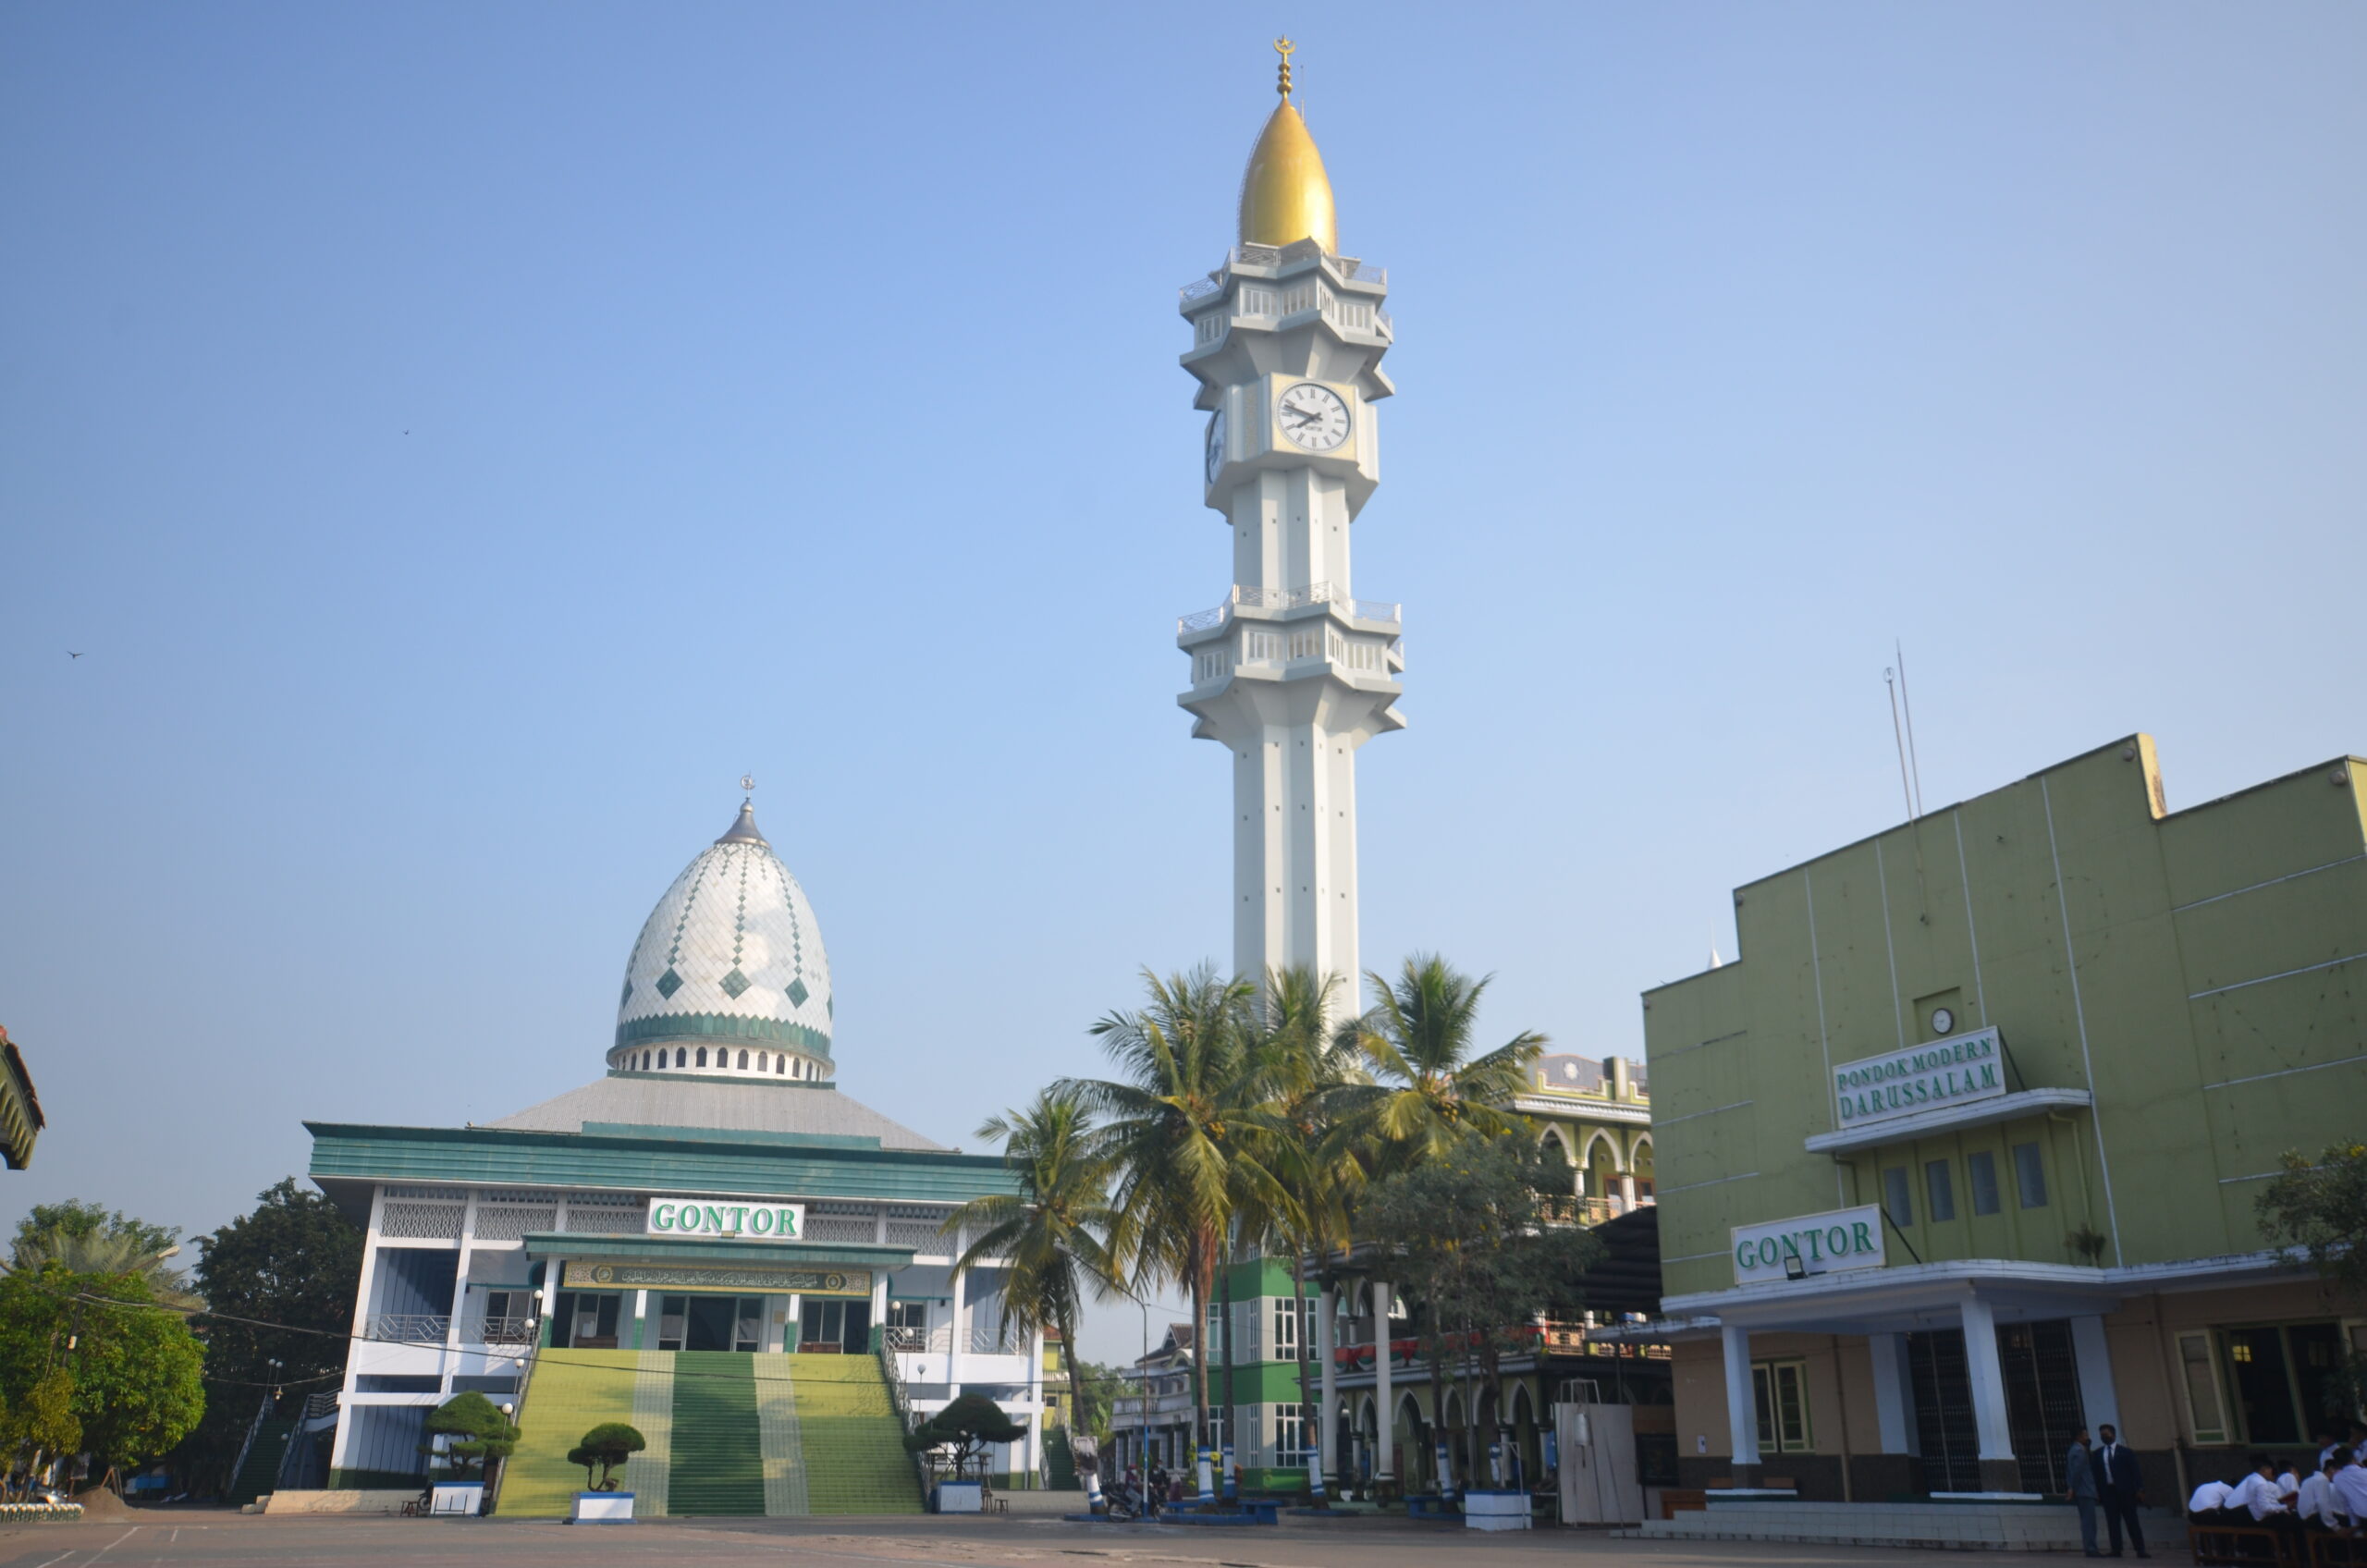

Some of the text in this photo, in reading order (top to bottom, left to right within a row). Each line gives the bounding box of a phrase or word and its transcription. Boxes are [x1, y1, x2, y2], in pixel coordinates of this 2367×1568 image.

[1837, 1037, 1995, 1091] PONDOK MODERN
[1839, 1062, 1999, 1120] DARUSSALAM
[653, 1203, 797, 1235] GONTOR
[1736, 1220, 1875, 1268] GONTOR
